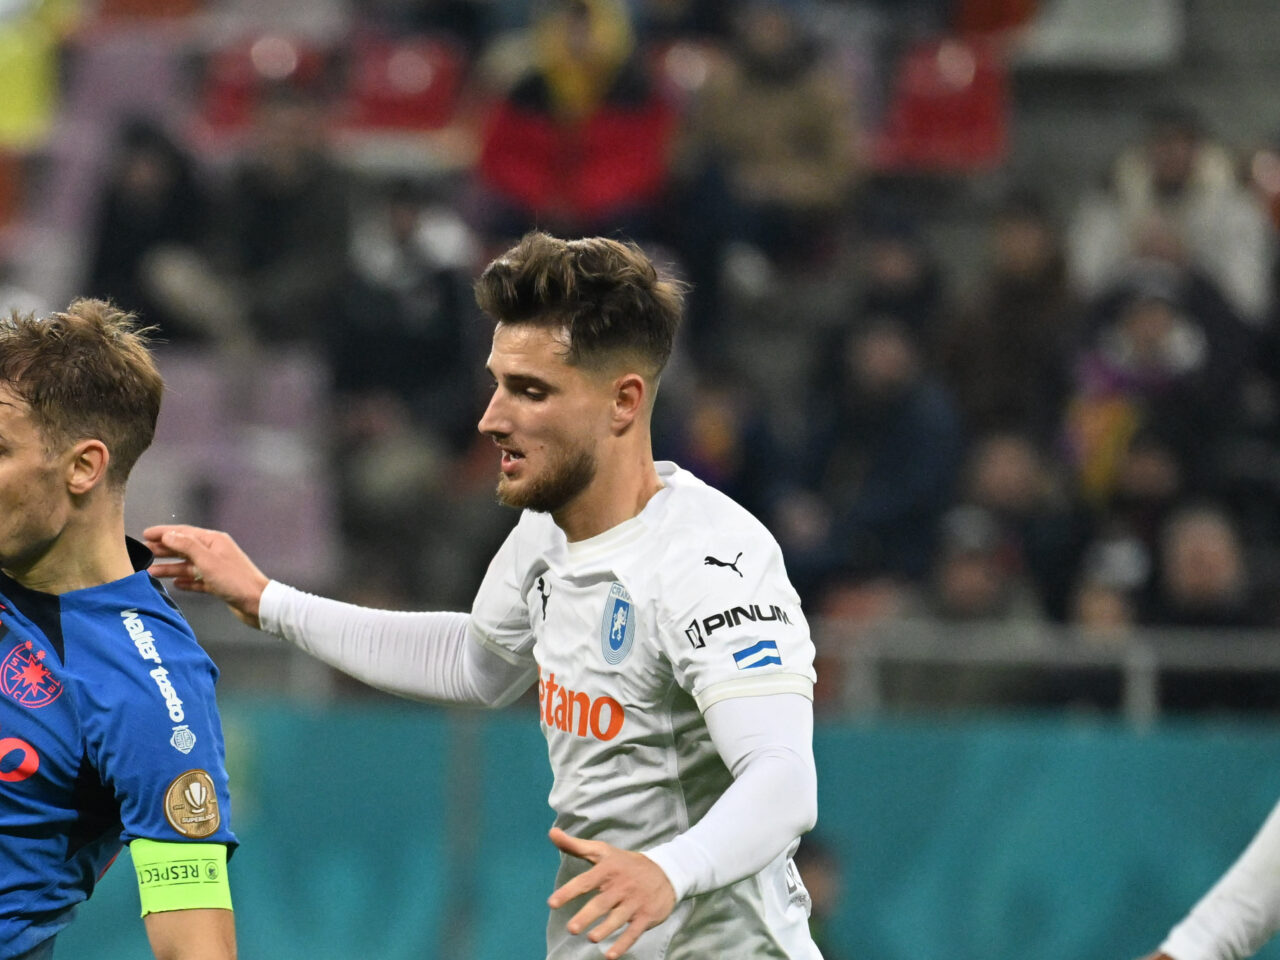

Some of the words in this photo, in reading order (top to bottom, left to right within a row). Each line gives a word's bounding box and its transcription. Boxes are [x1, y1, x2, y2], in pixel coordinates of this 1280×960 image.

[121, 608, 162, 664] walter
[149, 665, 185, 723] tosto
[537, 664, 625, 742] etano
